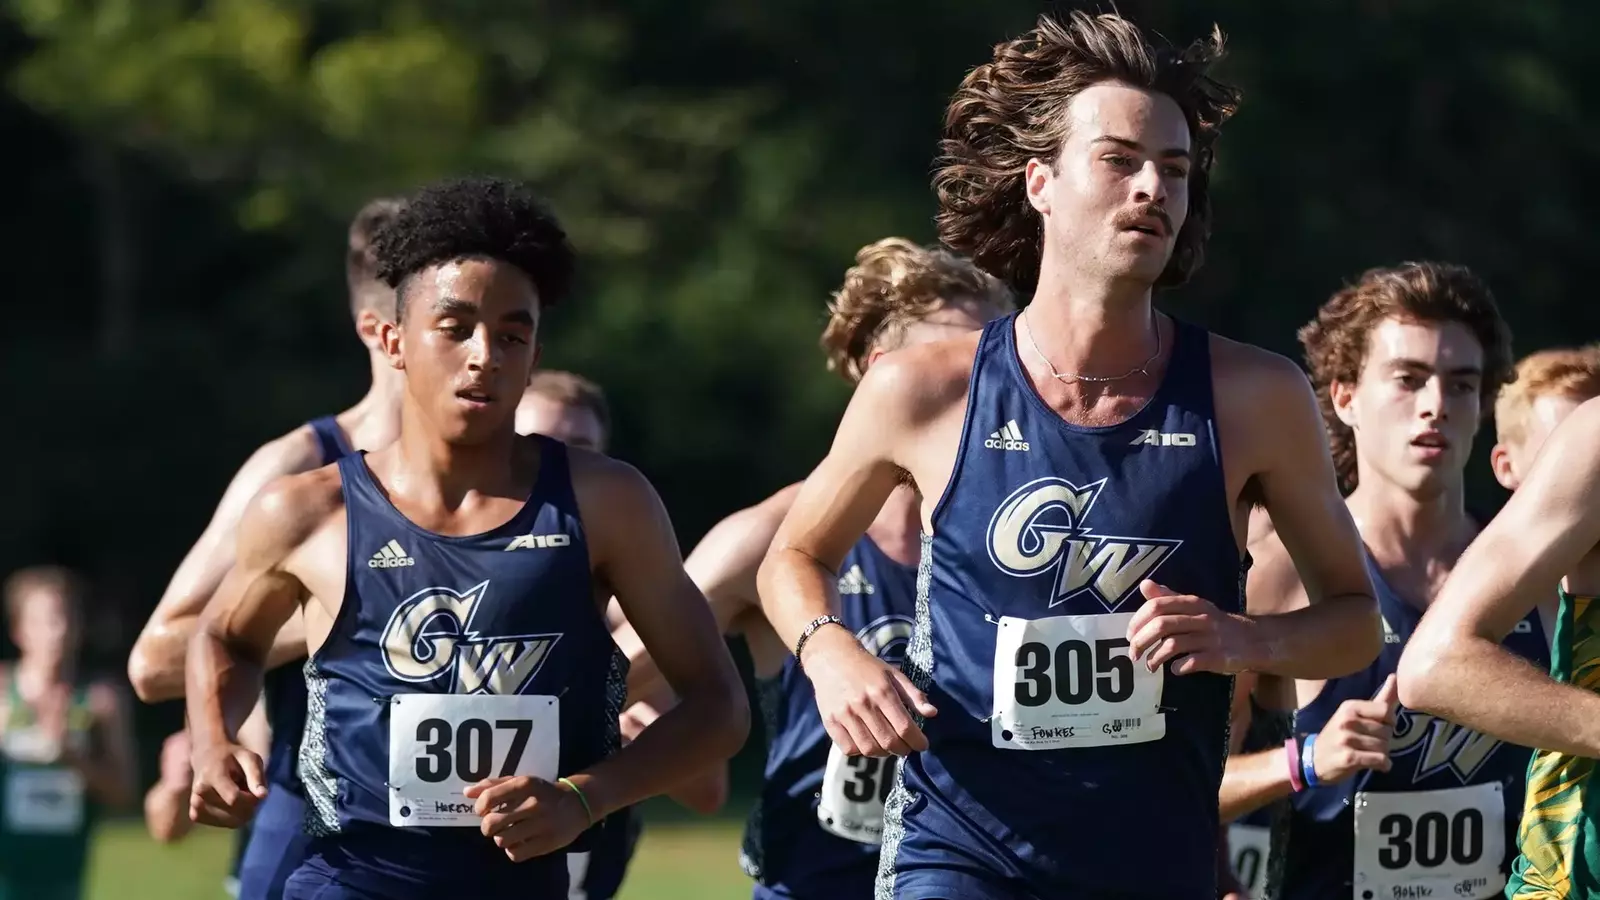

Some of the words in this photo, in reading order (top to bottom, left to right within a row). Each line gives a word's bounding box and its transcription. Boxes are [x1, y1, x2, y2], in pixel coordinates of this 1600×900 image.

[984, 437, 1030, 451] adidas
[1129, 429, 1196, 446] A10
[367, 554, 415, 569] adidas
[504, 533, 571, 551] A10
[986, 476, 1184, 614] GW
[379, 579, 564, 696] GW
[1013, 637, 1135, 707] 305
[414, 717, 534, 783] 307
[1377, 807, 1485, 871] 300
